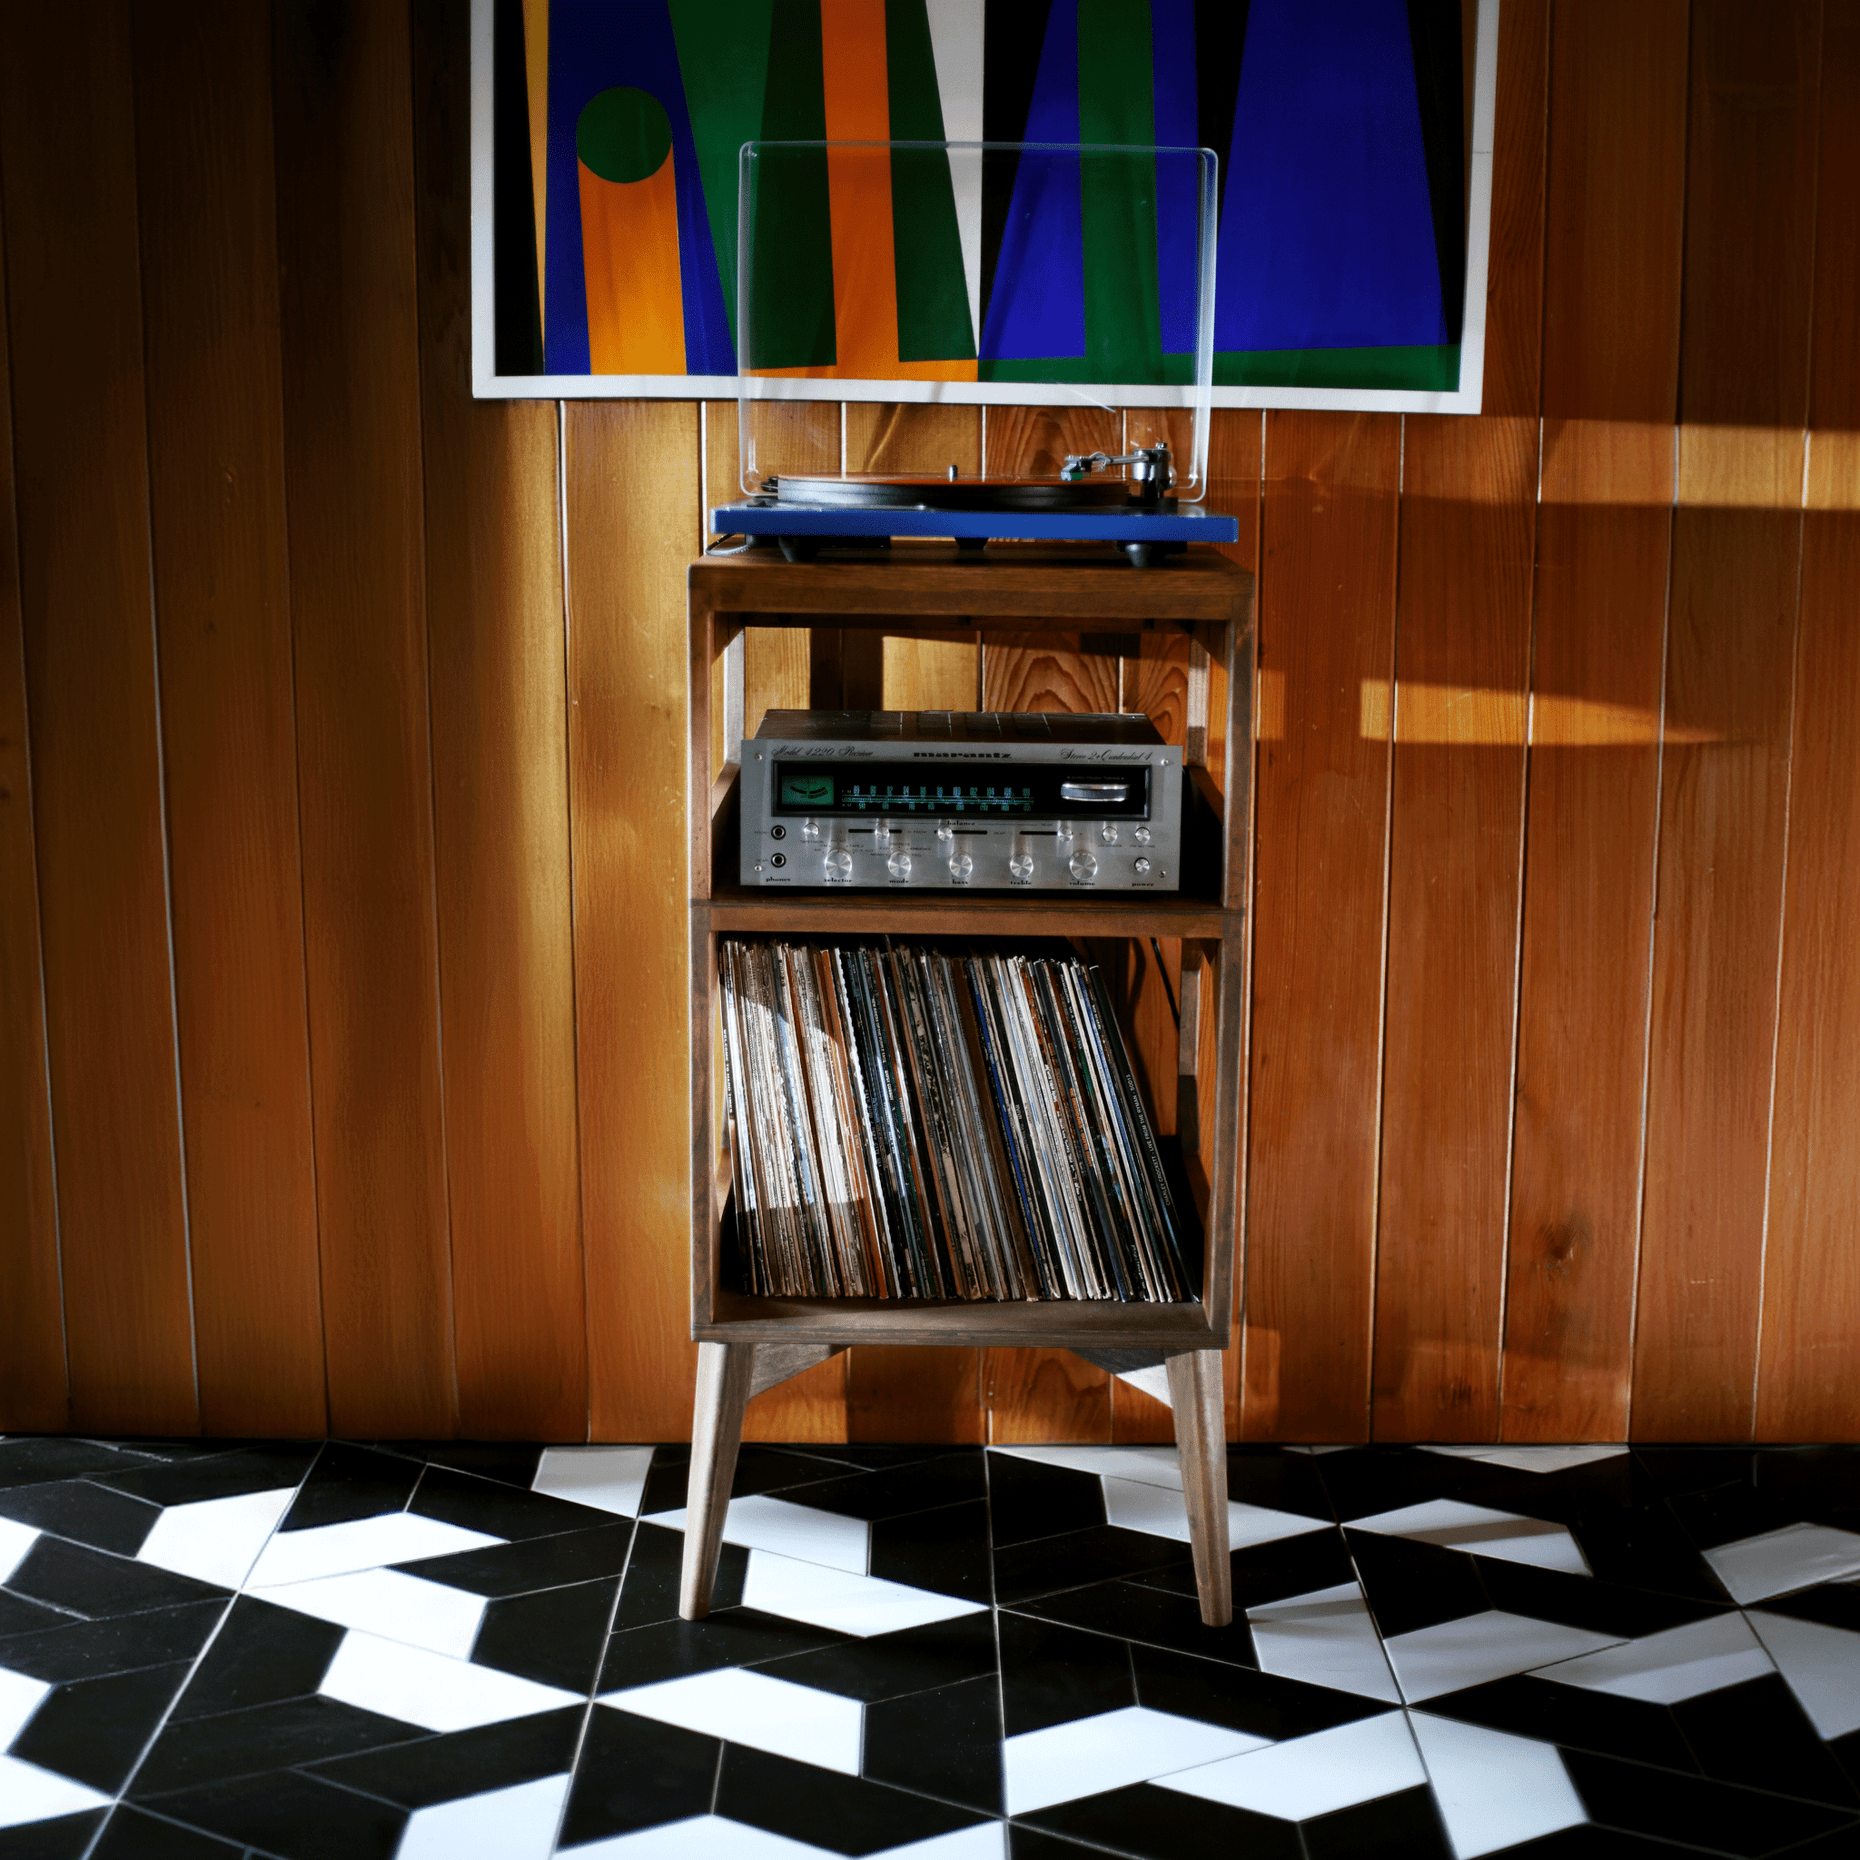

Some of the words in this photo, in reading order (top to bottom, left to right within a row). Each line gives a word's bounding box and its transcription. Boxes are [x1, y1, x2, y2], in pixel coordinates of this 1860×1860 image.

[771, 746, 802, 757] Model
[804, 746, 834, 757] 4220
[838, 746, 874, 757] Receiver
[1060, 748, 1086, 760] Stereo
[1131, 1094, 1142, 1113] RYMAN
[1137, 1113, 1145, 1124] THE
[1141, 1124, 1150, 1139] FROM
[1146, 1139, 1154, 1152] LIVE
[1150, 1154, 1164, 1182] CROCKETT
[1159, 1181, 1171, 1206] CHARLEY
